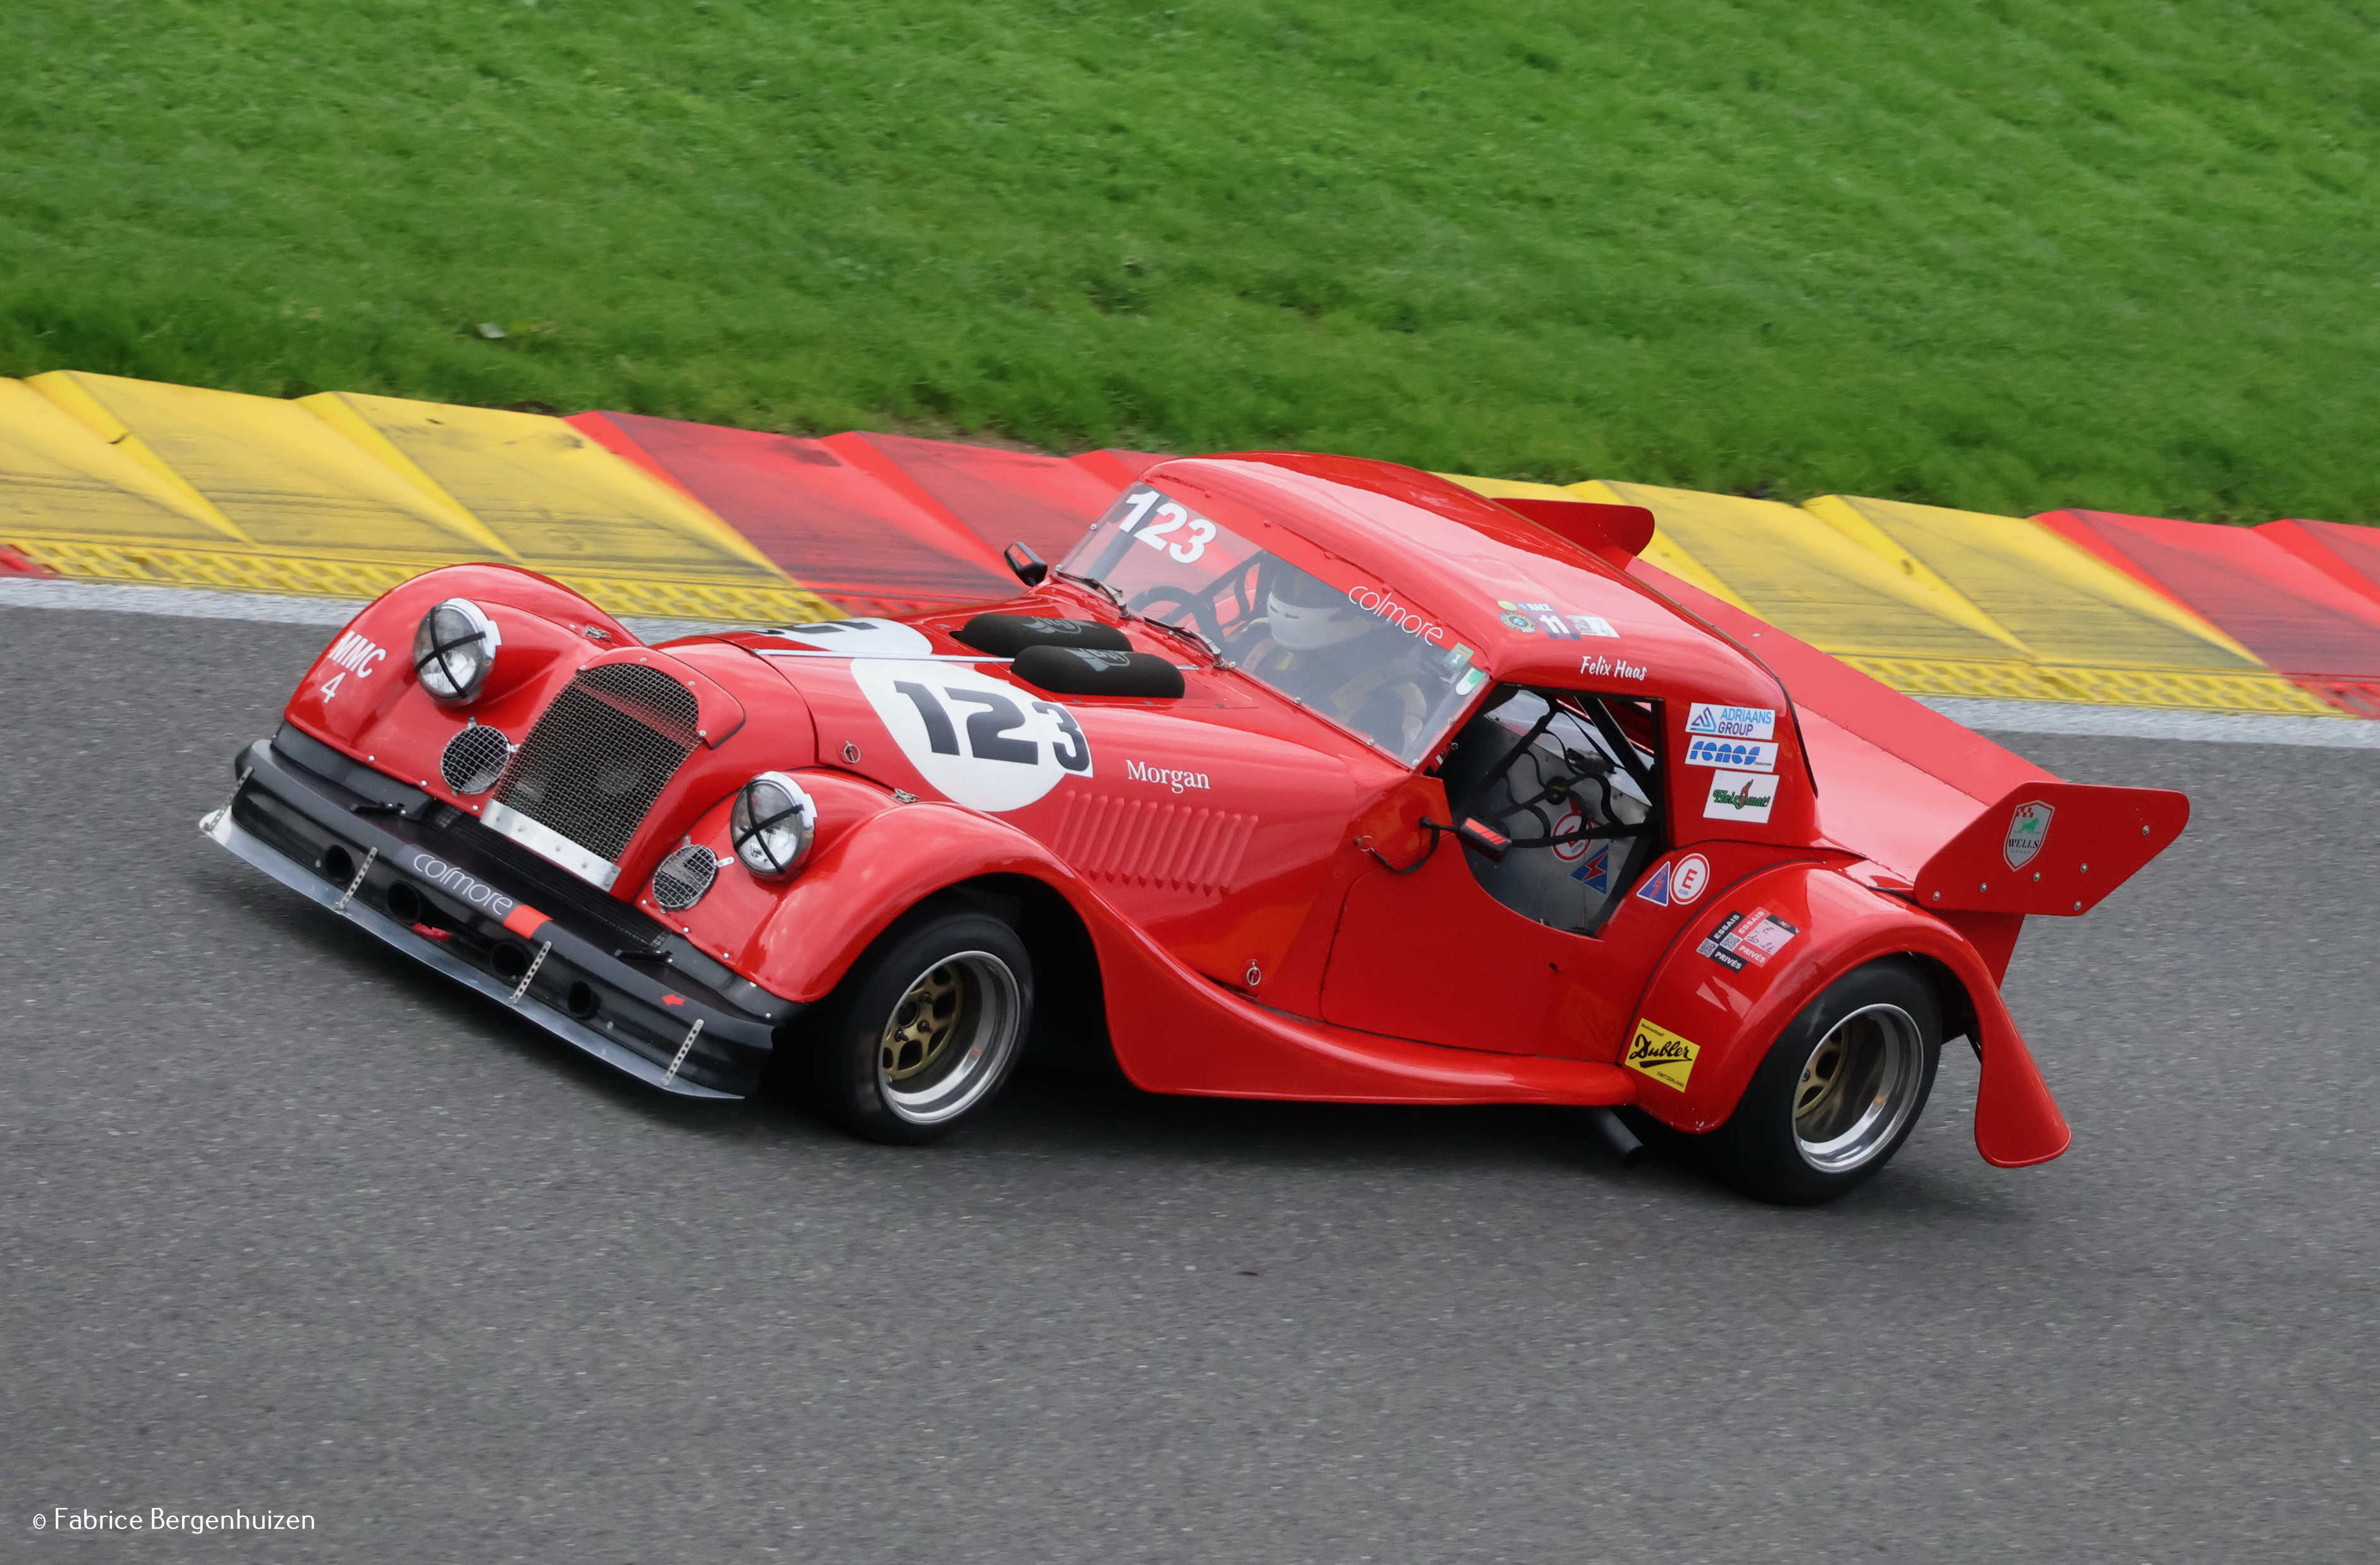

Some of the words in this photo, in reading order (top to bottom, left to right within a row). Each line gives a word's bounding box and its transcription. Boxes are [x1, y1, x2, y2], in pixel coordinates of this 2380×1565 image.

[1118, 490, 1217, 564] 123
[1348, 586, 1444, 646] colmore
[327, 630, 387, 678] MMC
[1580, 655, 1612, 676] Felix
[1614, 658, 1647, 681] Haas
[320, 672, 346, 704] 4
[893, 680, 1090, 772] 123
[1718, 721, 1754, 736] GROUP
[1720, 708, 1772, 724] ADRIAANS
[1125, 759, 1211, 794] Morgan
[2008, 838, 2040, 849] WELLS
[414, 854, 513, 916] colmore
[1681, 868, 1698, 890] E
[1713, 914, 1740, 940] ESSAIS
[1738, 911, 1765, 934] ESSAIS
[1714, 951, 1742, 969] PRIVÉS
[1739, 945, 1767, 963] PRIVÉS
